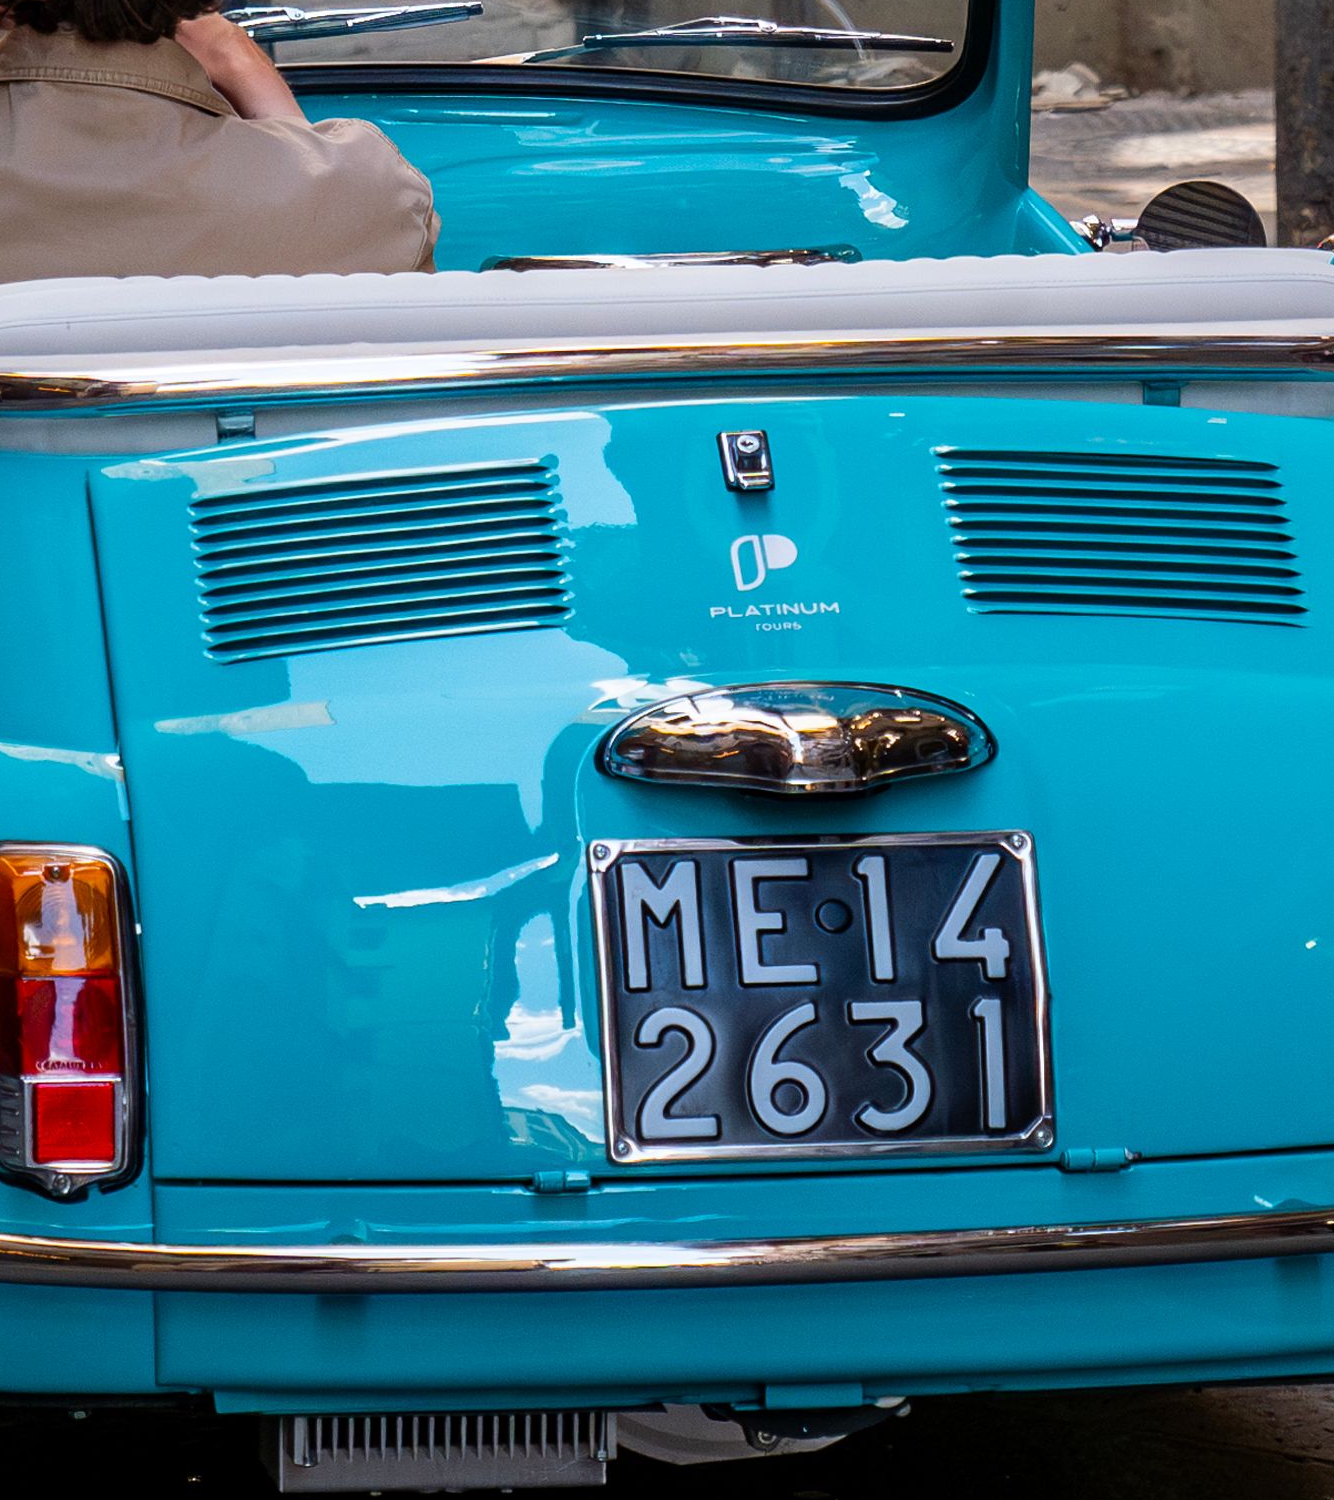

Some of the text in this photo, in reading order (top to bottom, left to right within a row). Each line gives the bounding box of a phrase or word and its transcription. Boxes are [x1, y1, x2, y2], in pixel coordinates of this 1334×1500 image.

[709, 602, 840, 619] PLATINUM
[755, 621, 803, 632] TOURS
[638, 998, 1007, 1139] 2631
